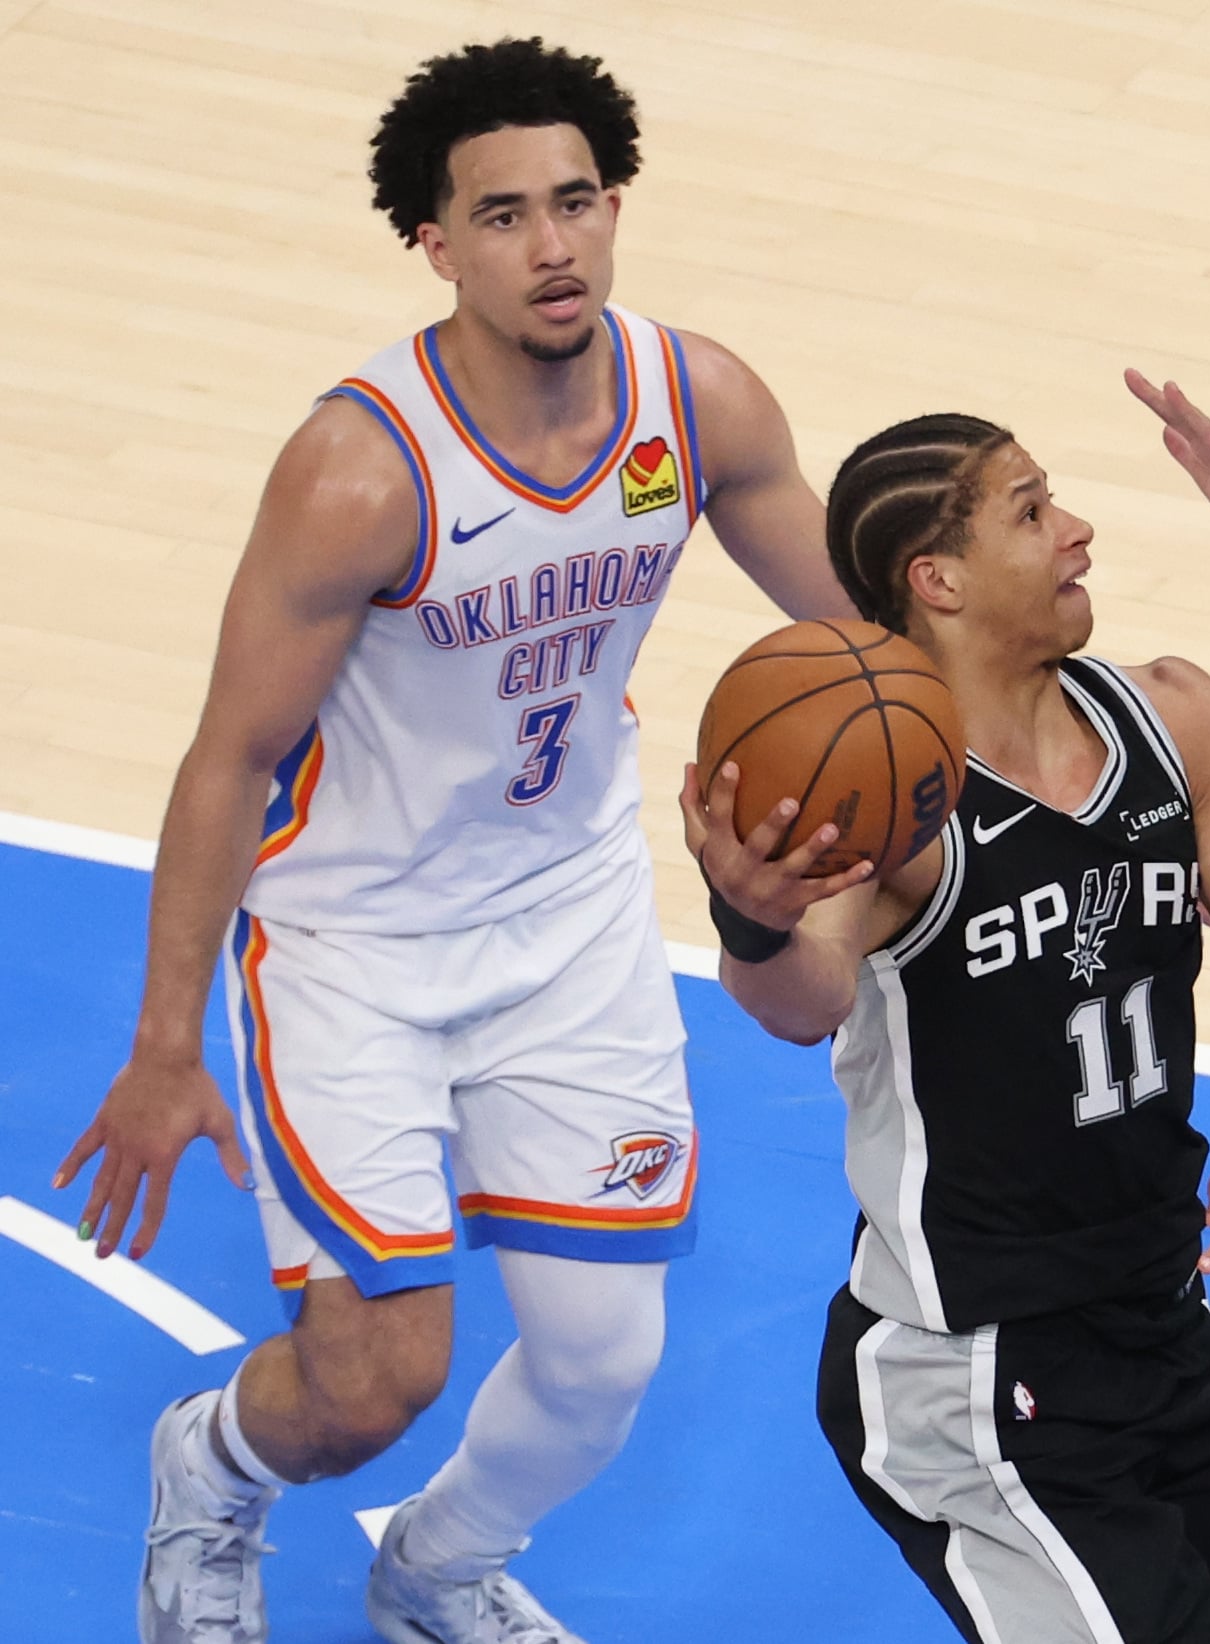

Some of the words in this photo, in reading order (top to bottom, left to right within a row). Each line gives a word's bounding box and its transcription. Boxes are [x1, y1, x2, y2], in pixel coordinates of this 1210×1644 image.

[498, 618, 616, 700] CITY
[505, 692, 581, 807] 3
[1130, 800, 1183, 831] LEDGER
[965, 861, 1200, 987] SPUR
[1066, 976, 1168, 1128] 11
[603, 1143, 669, 1189] OKC
